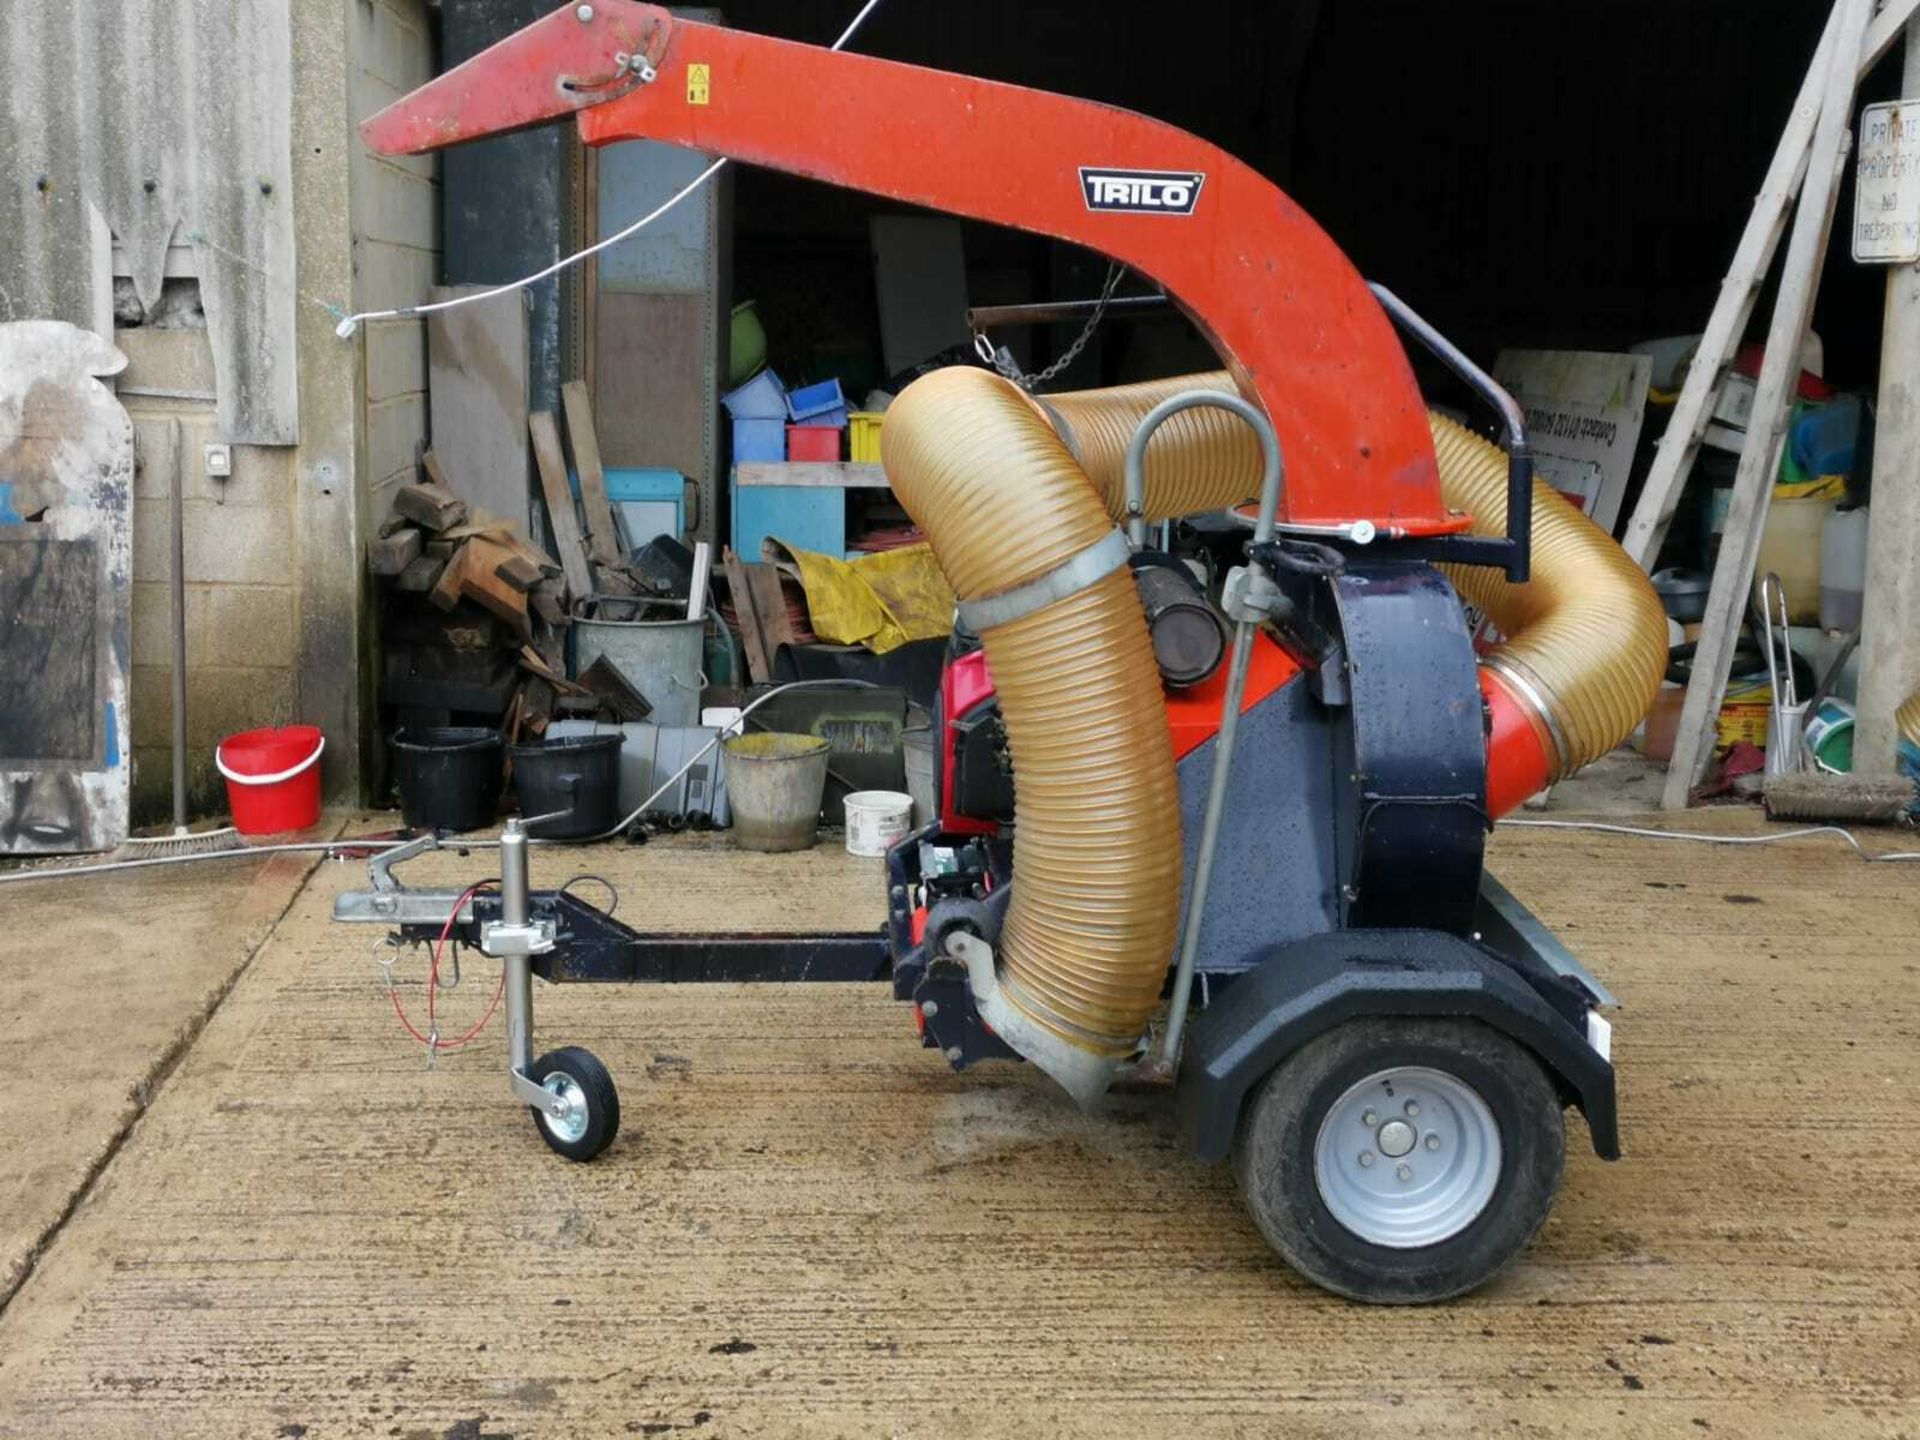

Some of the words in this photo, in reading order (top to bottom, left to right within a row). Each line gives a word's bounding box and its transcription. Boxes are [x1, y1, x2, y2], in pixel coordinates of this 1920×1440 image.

[1871, 120, 1917, 144] PRIVATE
[1087, 176, 1195, 207] TRILO
[1881, 192, 1897, 212] NO
